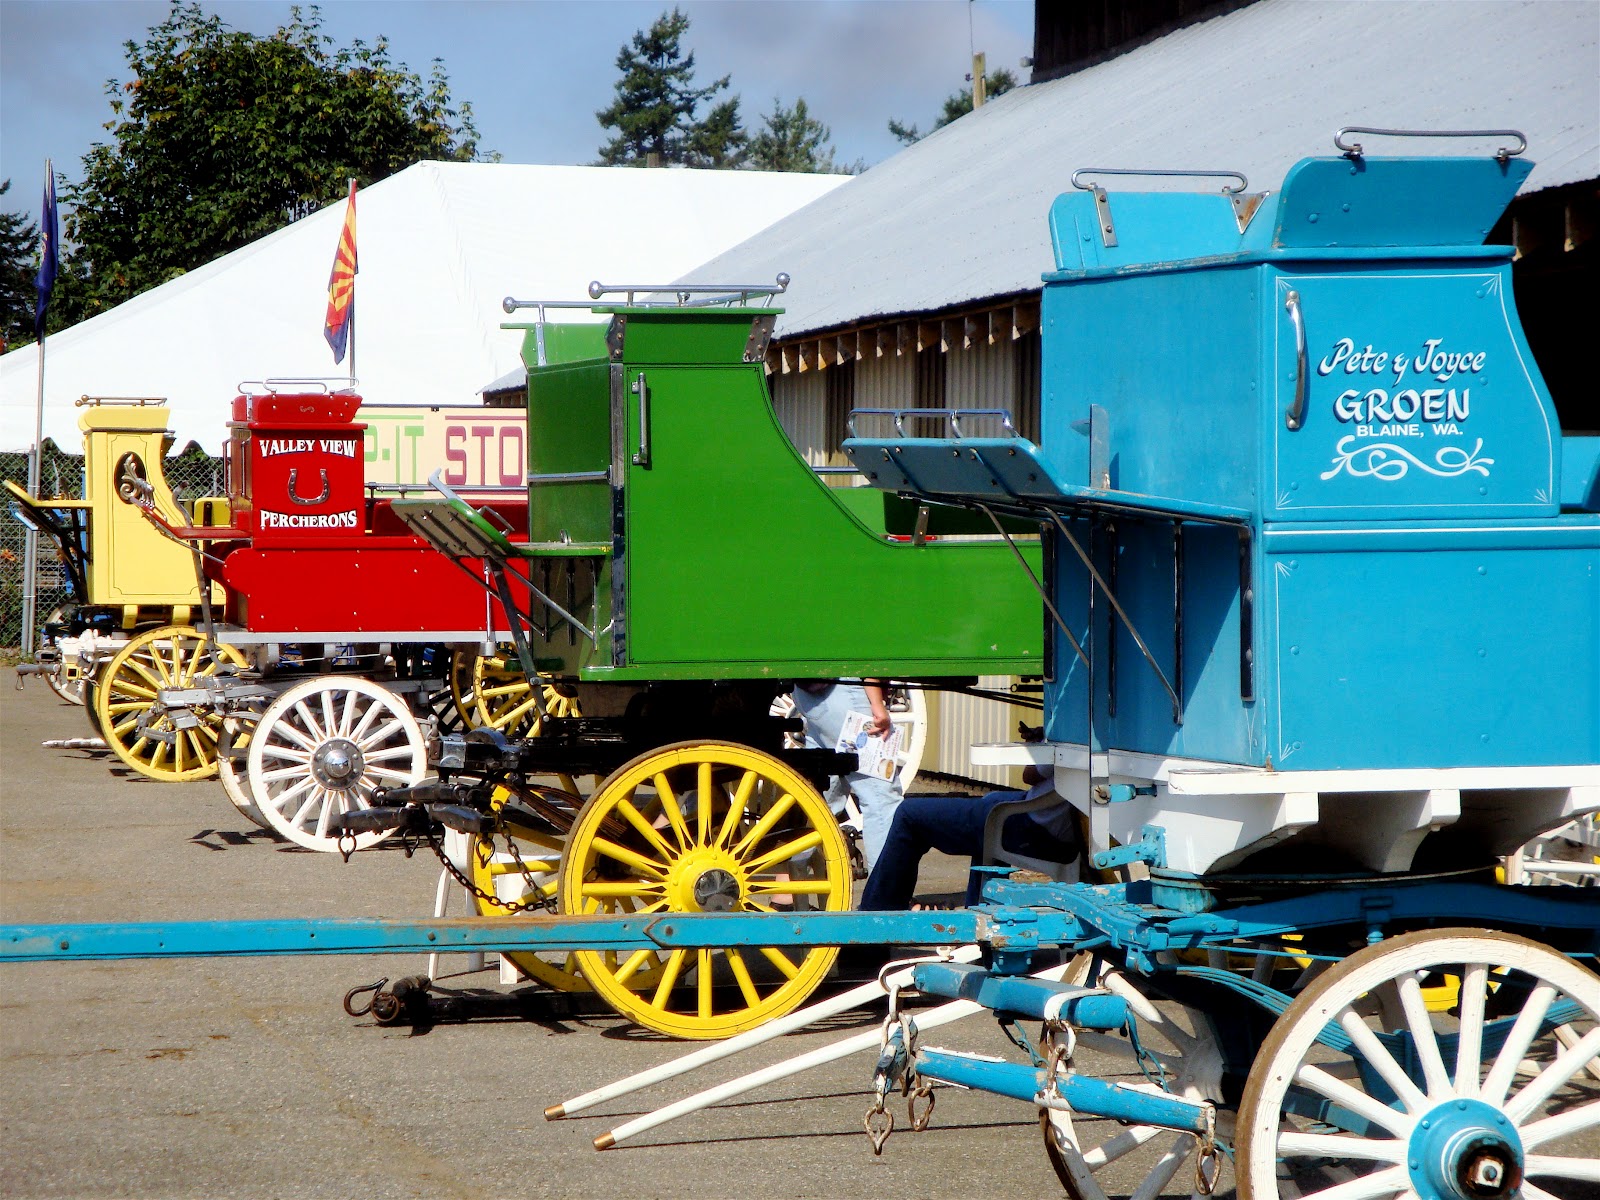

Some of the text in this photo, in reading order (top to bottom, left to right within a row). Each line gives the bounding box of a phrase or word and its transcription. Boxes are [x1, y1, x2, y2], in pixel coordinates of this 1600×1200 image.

[1317, 337, 1389, 376] Pete
[1413, 337, 1487, 382] Joyce
[1333, 388, 1470, 424] GROEN
[1356, 423, 1463, 438] BLAINE, WA.
[259, 439, 357, 458] VALLEY VIEW
[445, 426, 523, 486] STO
[260, 510, 357, 529] PERCHERONS
